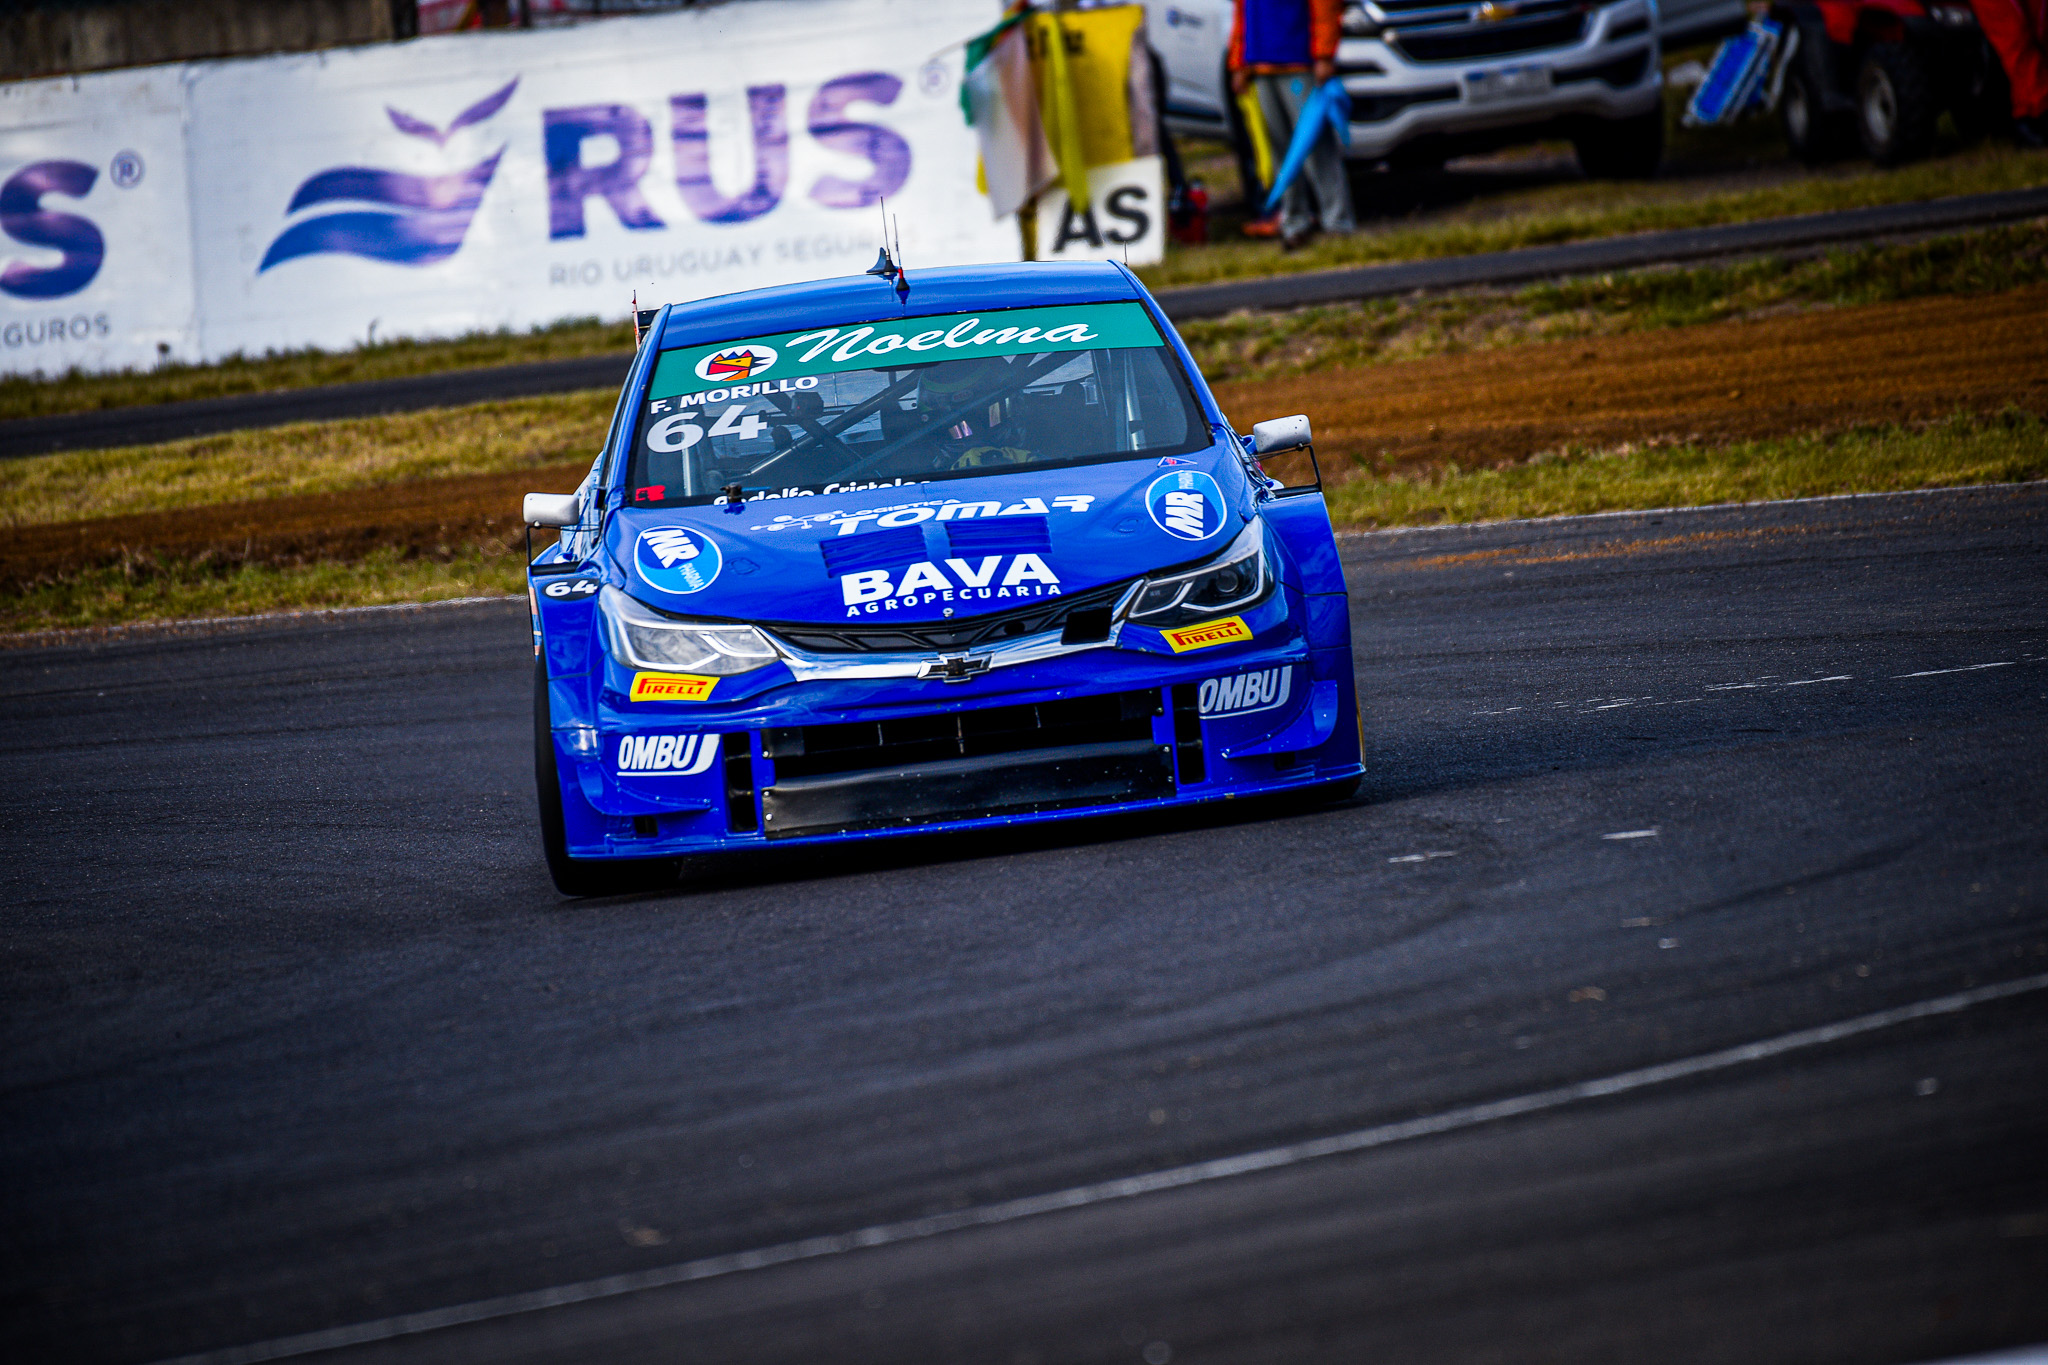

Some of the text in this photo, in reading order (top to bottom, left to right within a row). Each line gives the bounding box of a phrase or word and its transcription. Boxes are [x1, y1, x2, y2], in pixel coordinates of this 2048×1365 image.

[551, 261, 602, 286] RIO
[613, 246, 762, 279] URUGUAY
[786, 318, 1098, 362] Noelma
[650, 376, 819, 415] F. MORILLO
[646, 404, 768, 453] 64
[829, 494, 1096, 536] TOMAR
[841, 499, 961, 518] LOGISTICA
[1165, 491, 1204, 538] MR
[642, 529, 700, 569] MR
[545, 580, 598, 597] 64
[840, 553, 1061, 606] BAVA
[846, 585, 1062, 617] AGROPECUARIA
[1170, 621, 1243, 646] PIRELLI
[637, 678, 708, 695] PIRELLI
[1198, 668, 1279, 714] OMBU
[618, 734, 700, 770] OMBU
